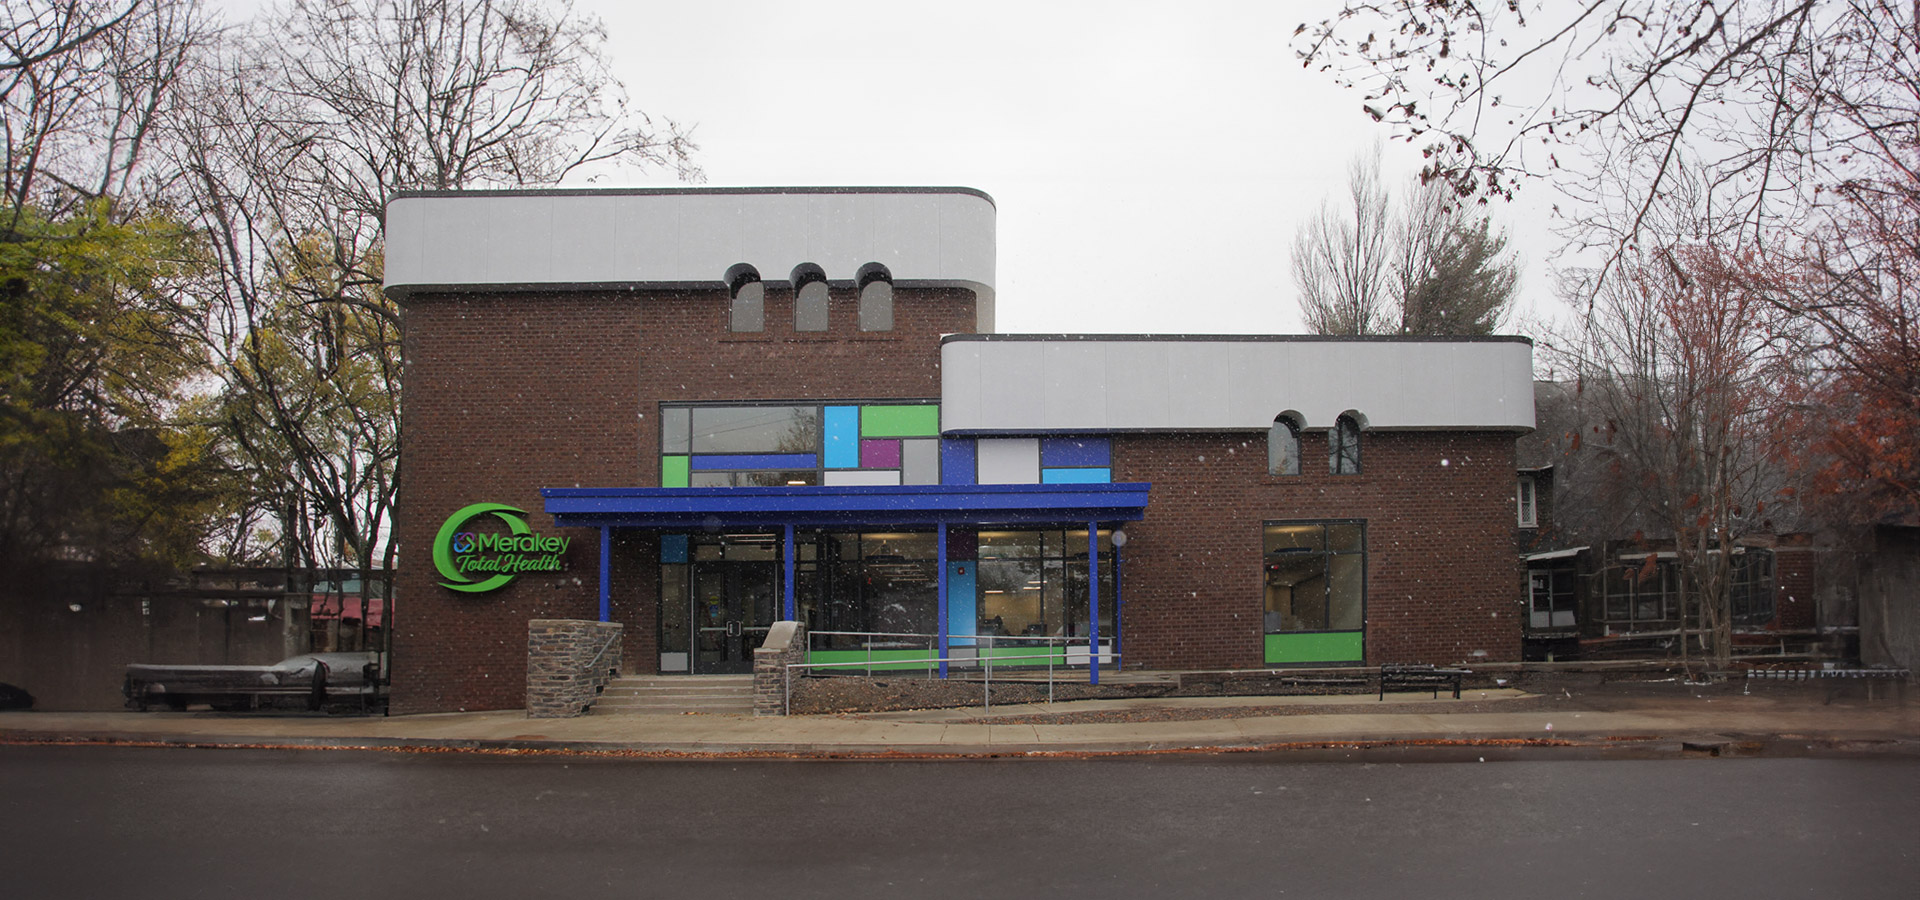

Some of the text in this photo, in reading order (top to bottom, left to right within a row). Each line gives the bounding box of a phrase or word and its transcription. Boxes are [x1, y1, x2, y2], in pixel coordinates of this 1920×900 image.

[478, 532, 571, 555] Merakey
[456, 553, 562, 573] Total Health
